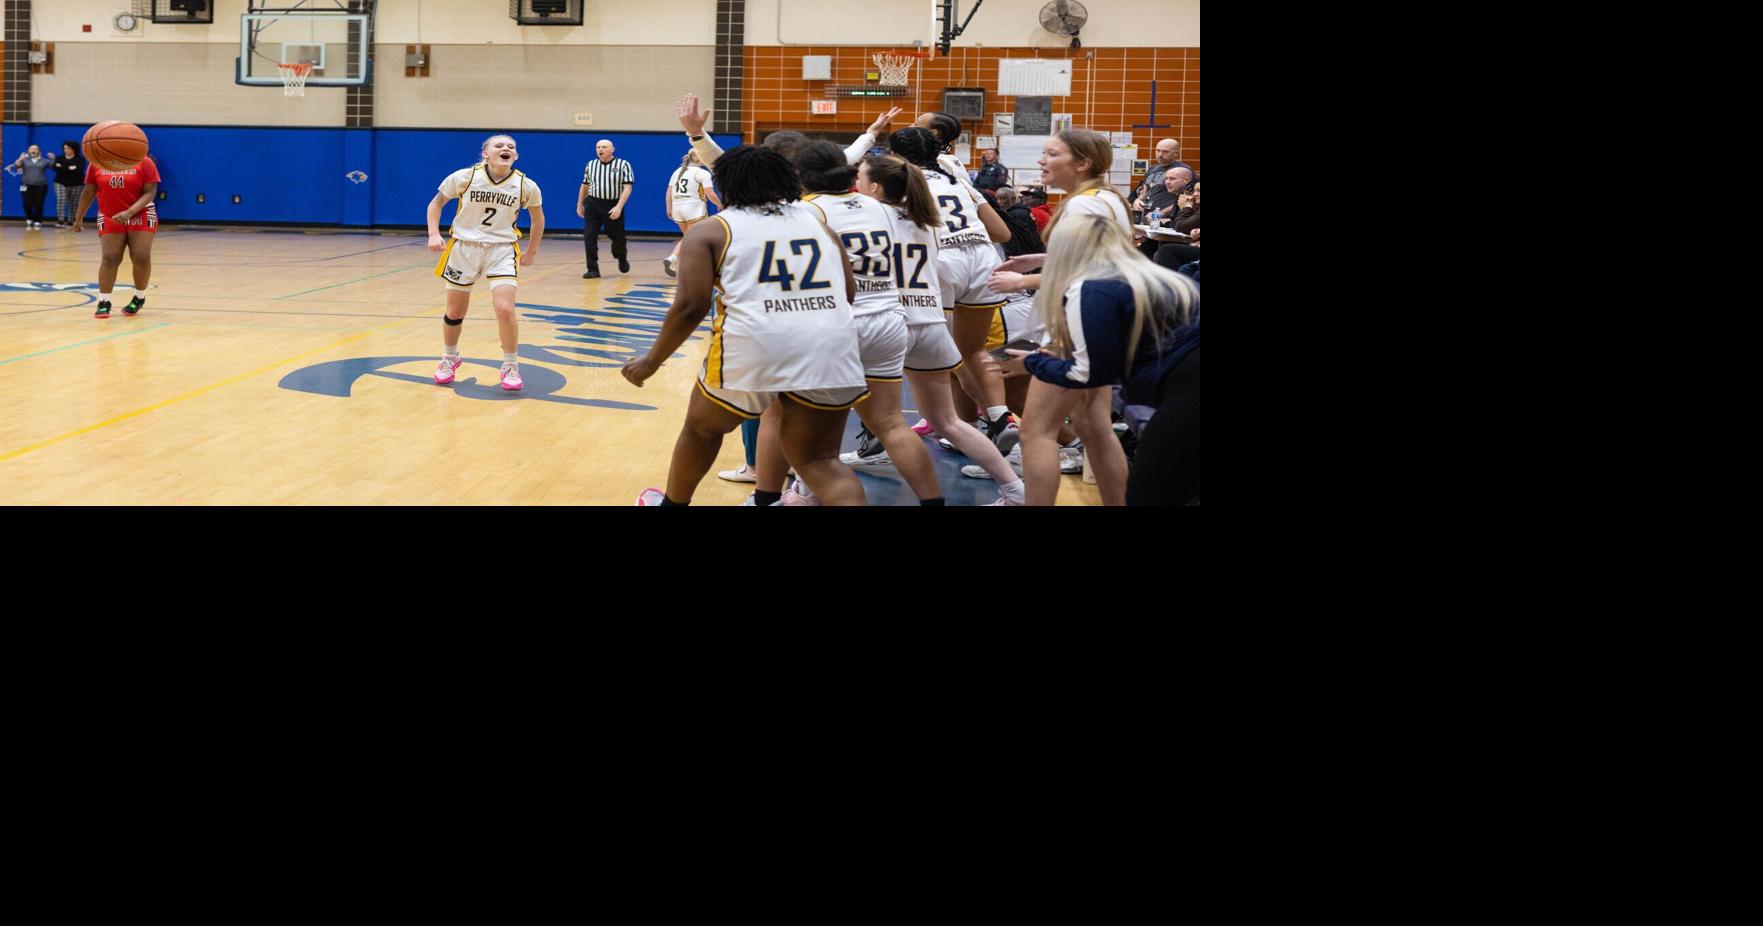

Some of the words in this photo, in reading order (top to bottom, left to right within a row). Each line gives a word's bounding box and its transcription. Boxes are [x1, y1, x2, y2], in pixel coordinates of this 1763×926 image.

[817, 102, 833, 112] EXIT
[109, 174, 125, 188] 44
[470, 190, 517, 207] PERRYVILLE
[481, 207, 497, 226] 2
[938, 195, 970, 232] 3
[841, 230, 891, 277] 33
[758, 238, 832, 291] 42
[893, 243, 928, 289] 12
[764, 295, 836, 312] PANTHERS
[898, 294, 937, 307] NTHERS
